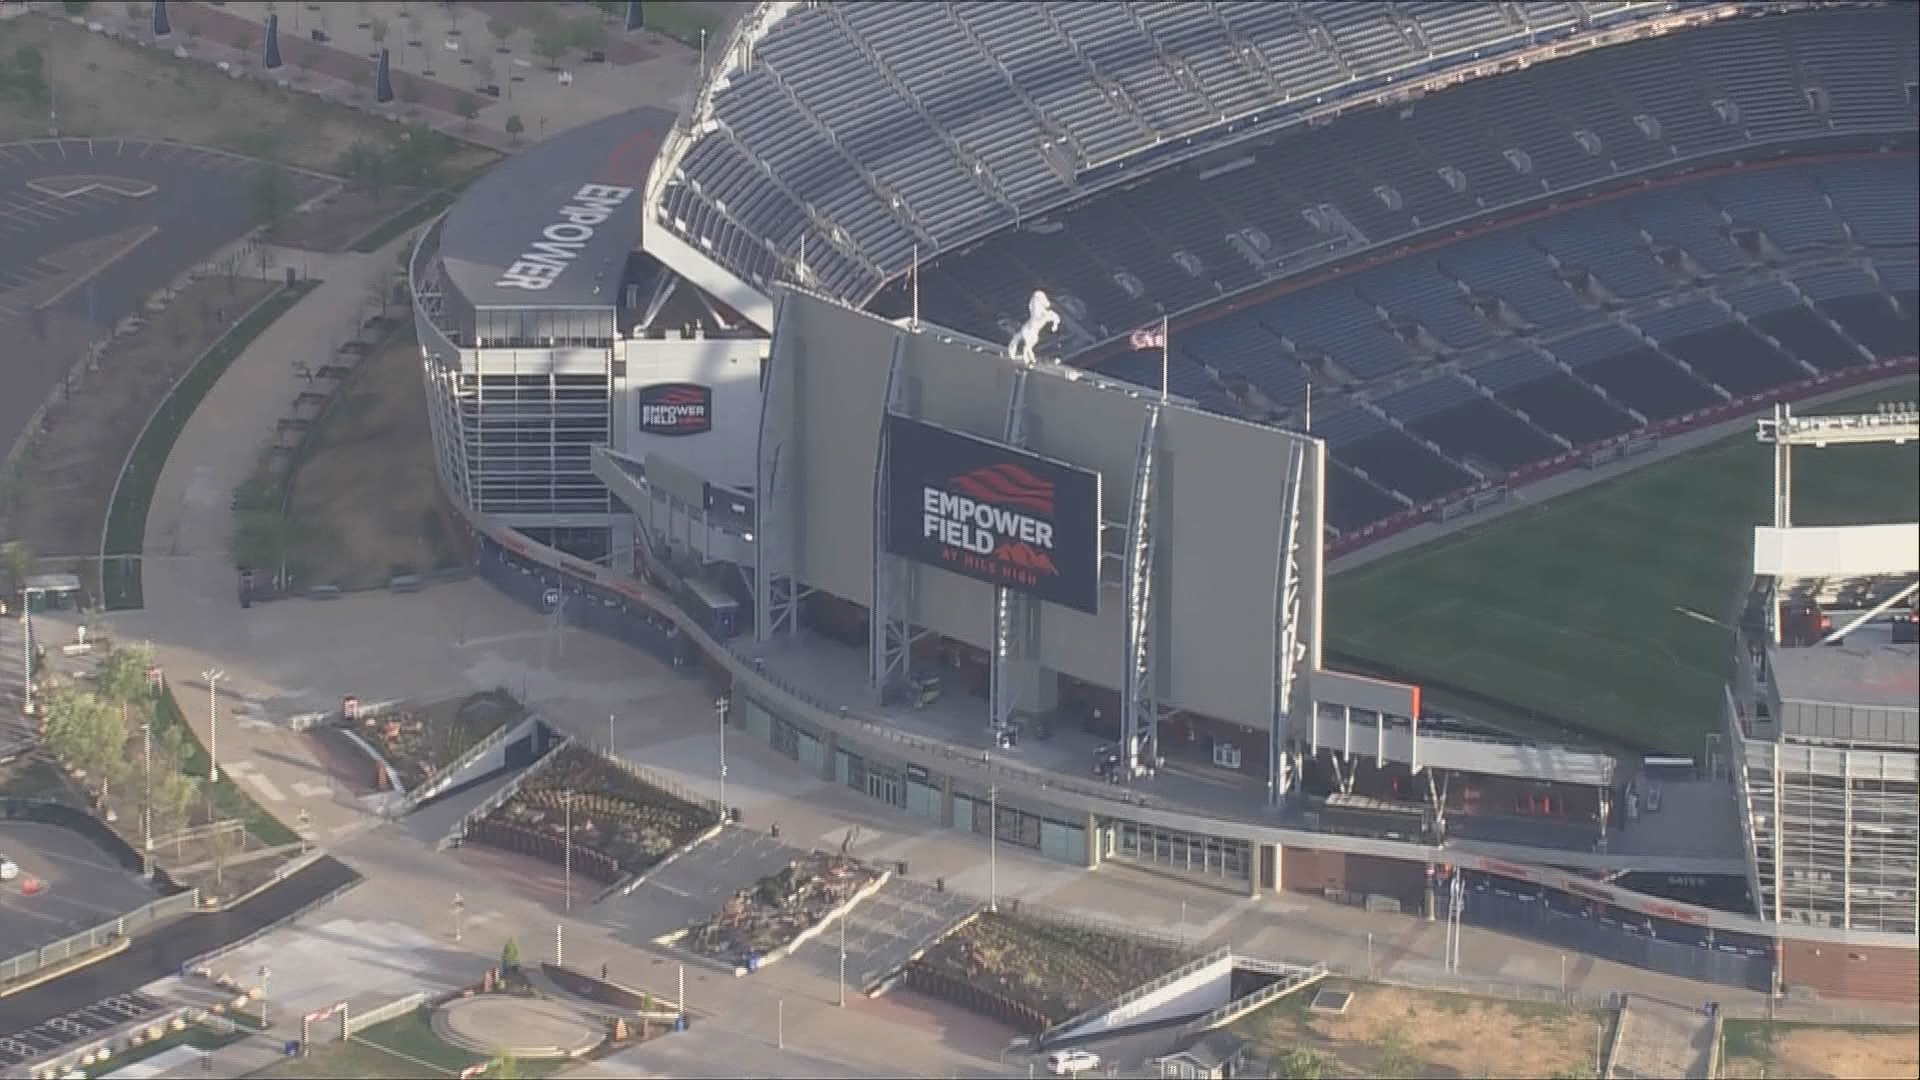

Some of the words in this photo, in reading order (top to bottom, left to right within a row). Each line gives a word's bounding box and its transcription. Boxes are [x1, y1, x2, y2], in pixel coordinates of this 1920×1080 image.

[494, 183, 634, 290] EMPOWER
[642, 405, 704, 416] EMPOWER
[642, 415, 677, 425] FIELD
[924, 487, 1053, 548] EMPOWER
[924, 513, 994, 554] FIELD
